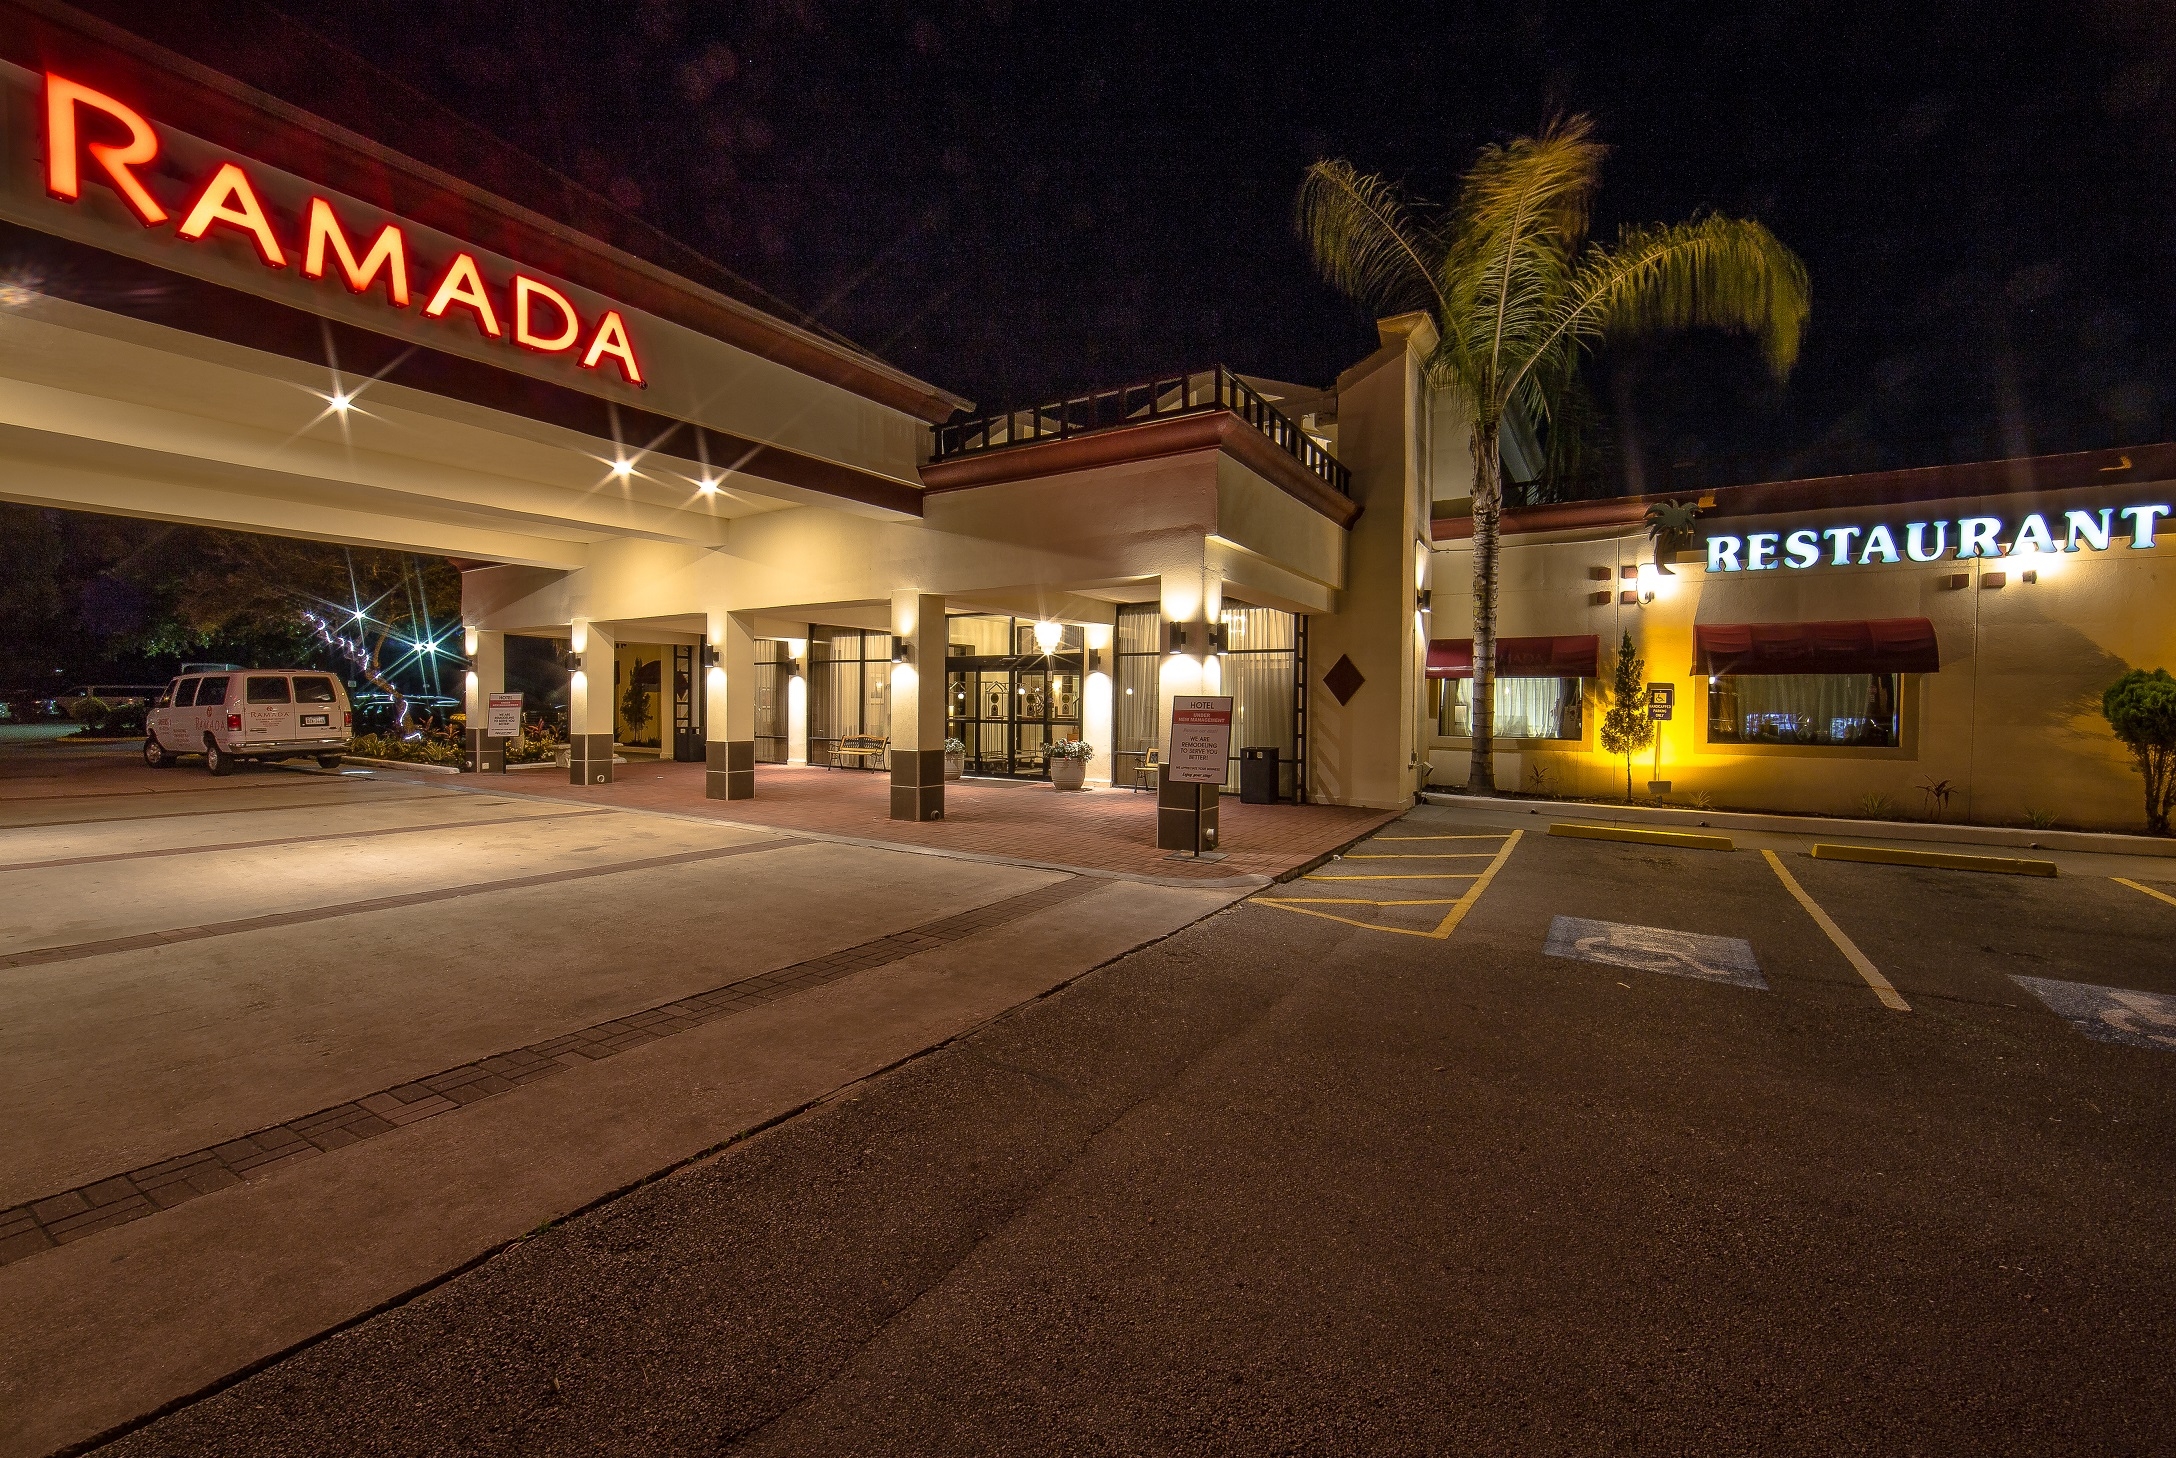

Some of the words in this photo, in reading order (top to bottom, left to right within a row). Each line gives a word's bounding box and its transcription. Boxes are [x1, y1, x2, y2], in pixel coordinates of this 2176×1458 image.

[46, 71, 642, 385] RAMADA
[1705, 504, 2171, 573] RESTAURANT
[1190, 701, 1214, 709] HOTEL
